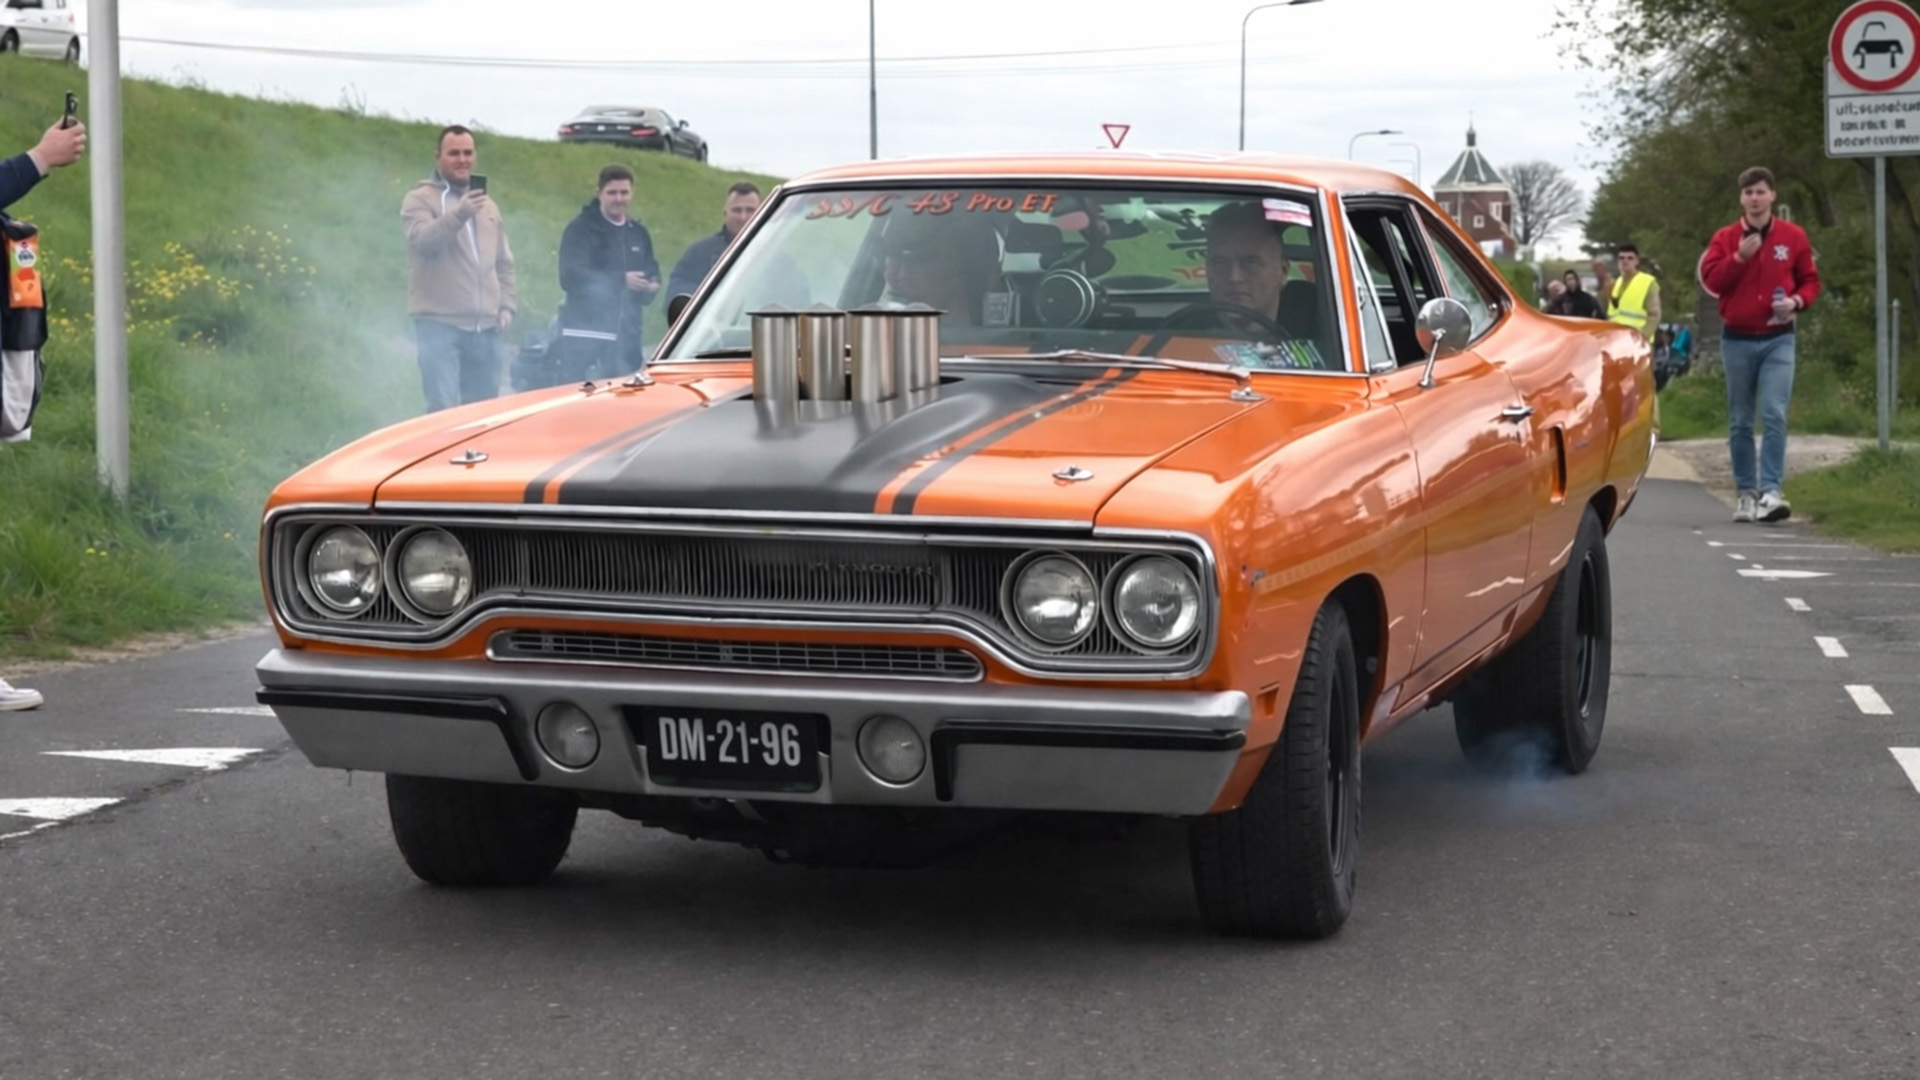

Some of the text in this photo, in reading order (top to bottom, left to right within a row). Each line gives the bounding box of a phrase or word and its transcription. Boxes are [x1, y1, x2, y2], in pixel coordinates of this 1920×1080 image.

[966, 190, 1015, 213] Pro
[1020, 191, 1059, 213] ET
[658, 716, 801, 767] DM-21-96
